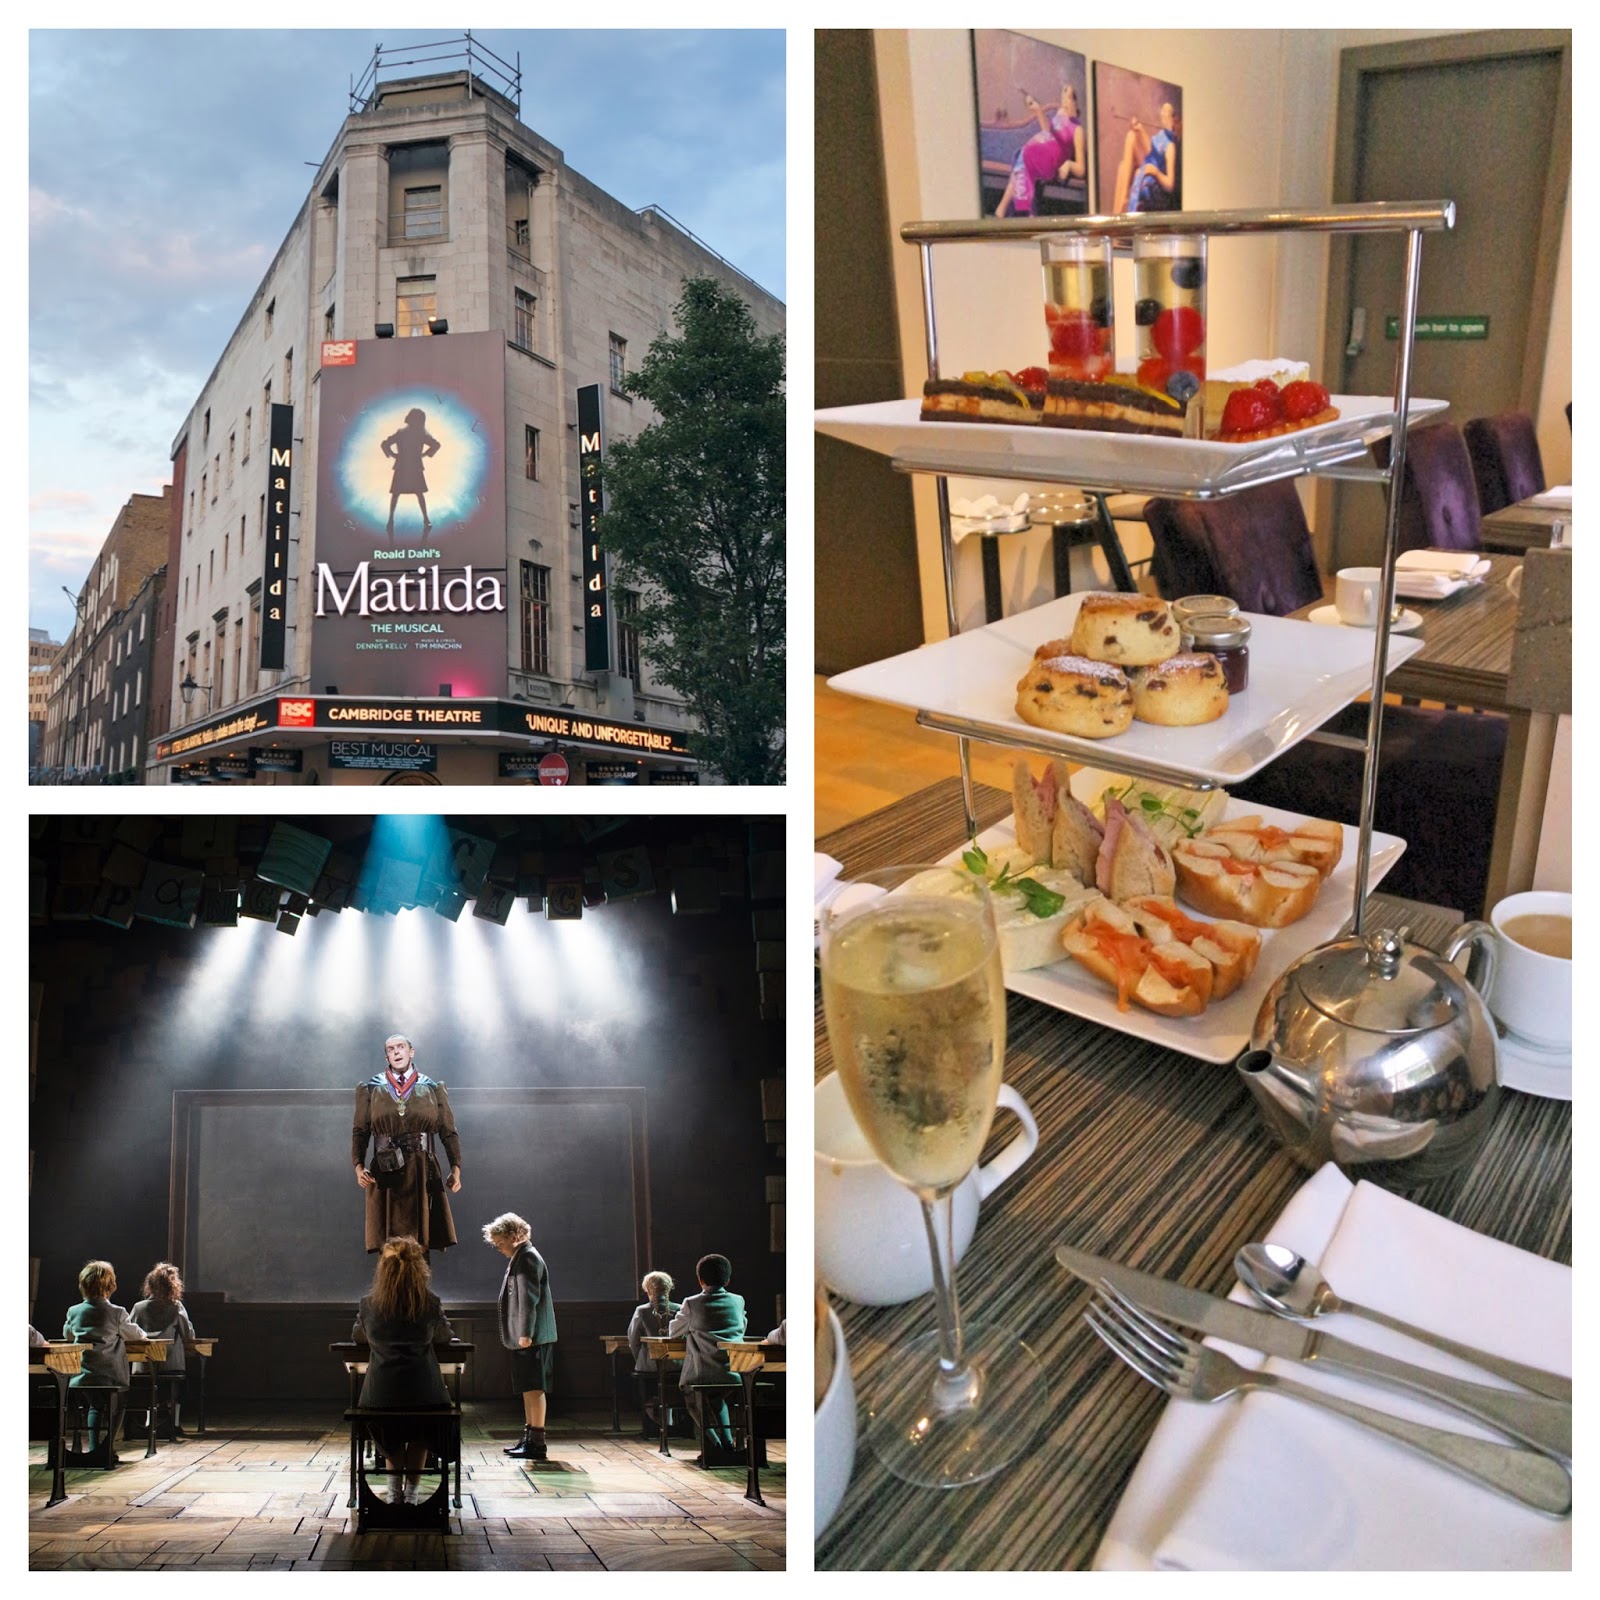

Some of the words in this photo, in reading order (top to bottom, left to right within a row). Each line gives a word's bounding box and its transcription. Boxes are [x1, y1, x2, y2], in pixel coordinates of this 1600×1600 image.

[1432, 323, 1447, 333] bar
[1448, 323, 1459, 332] to
[1461, 324, 1485, 334] open
[323, 342, 354, 357] RSC
[269, 448, 291, 621] Matilda
[374, 550, 405, 560] Roald
[408, 549, 441, 559] Dahl's
[315, 561, 505, 616] Matilda
[371, 624, 392, 633] THE
[394, 624, 444, 633] MUSICAL
[281, 702, 312, 717] RSC
[328, 708, 413, 722] CAMBRIDGE
[416, 709, 481, 723] THEATRE
[570, 721, 593, 738] AND
[331, 742, 368, 755] BEST
[371, 744, 435, 758] MUSICAL
